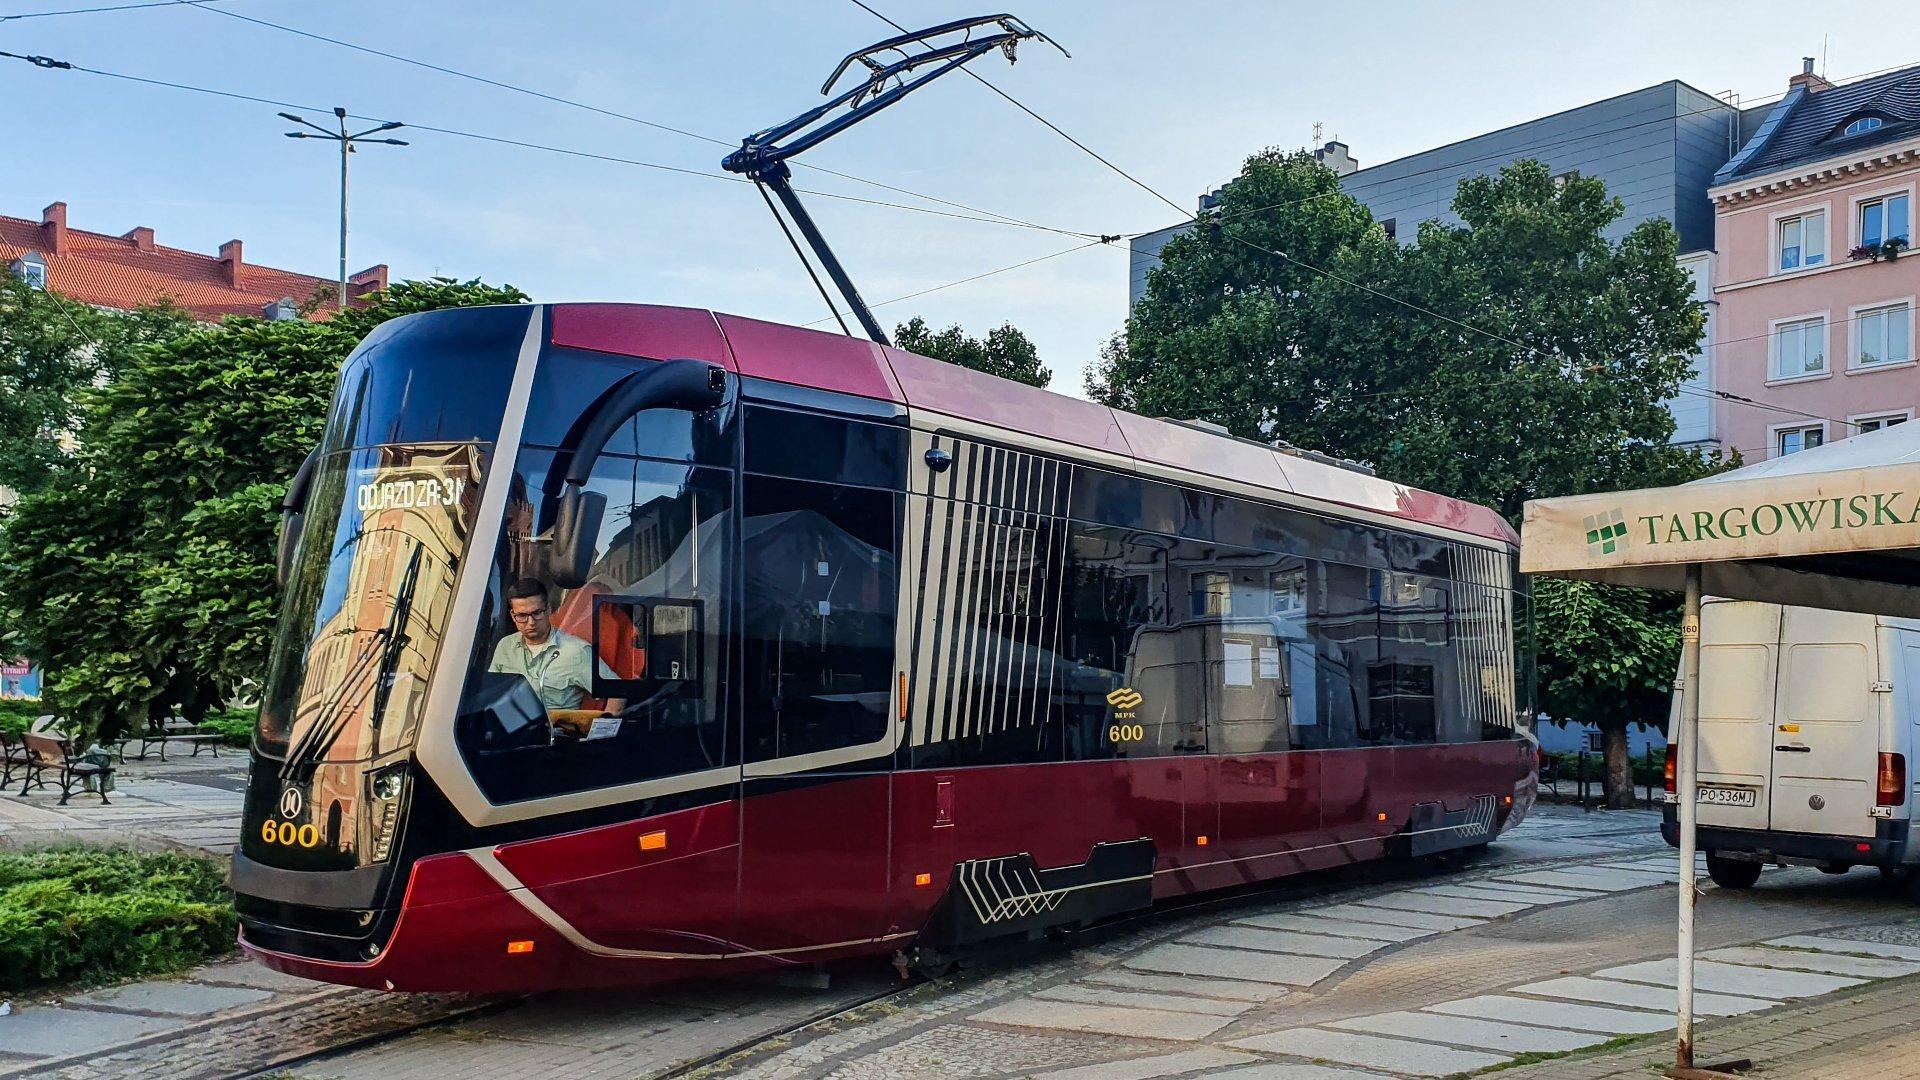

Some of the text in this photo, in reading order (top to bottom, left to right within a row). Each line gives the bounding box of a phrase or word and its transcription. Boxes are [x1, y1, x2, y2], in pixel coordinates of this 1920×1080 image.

[357, 480, 415, 511] ODJAZD
[1683, 625, 1698, 634] 160
[1109, 724, 1144, 742] 600
[262, 819, 319, 849] 600
